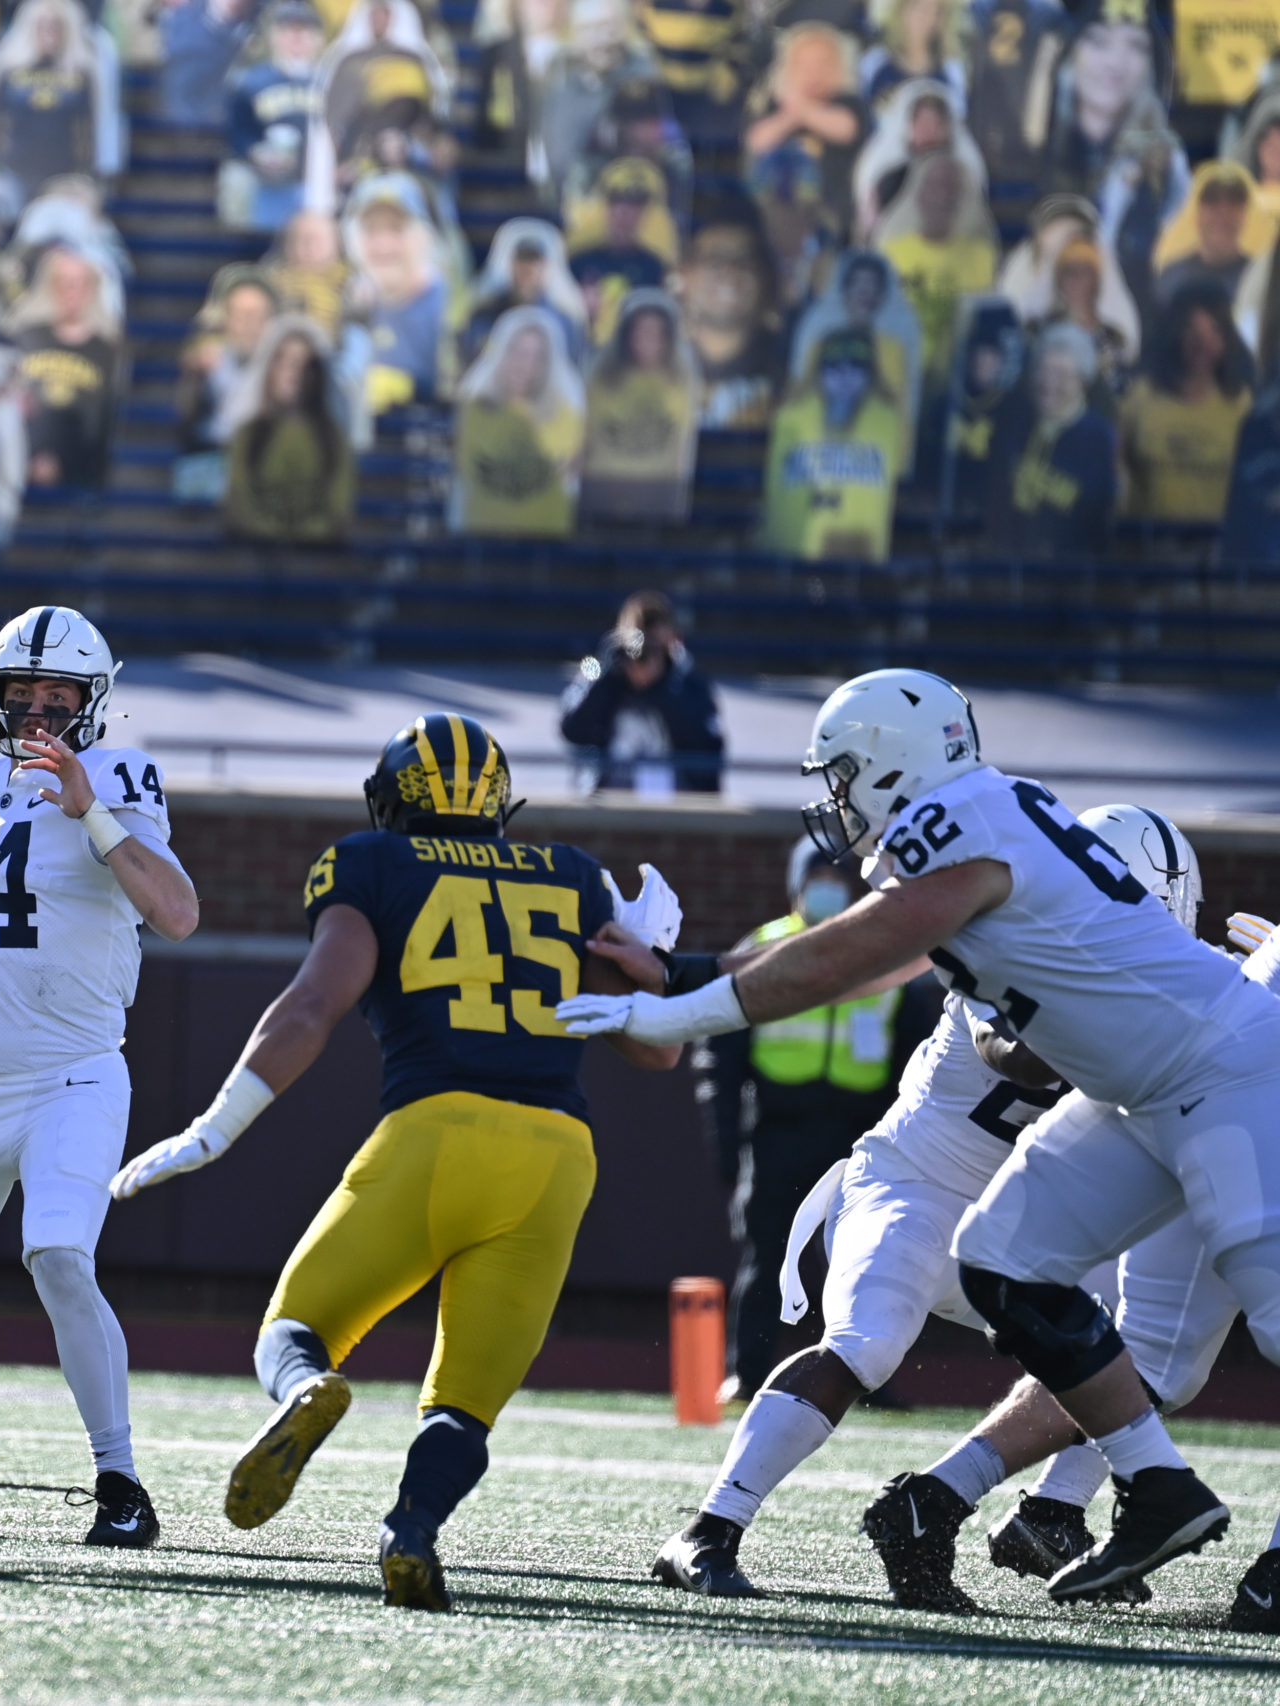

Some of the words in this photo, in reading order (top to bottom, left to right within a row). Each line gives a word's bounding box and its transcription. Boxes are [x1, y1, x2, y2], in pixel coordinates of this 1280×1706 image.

[113, 762, 164, 806] 14
[409, 836, 555, 872] SHIBLEY
[884, 802, 963, 874] 62
[399, 874, 589, 1039] 45
